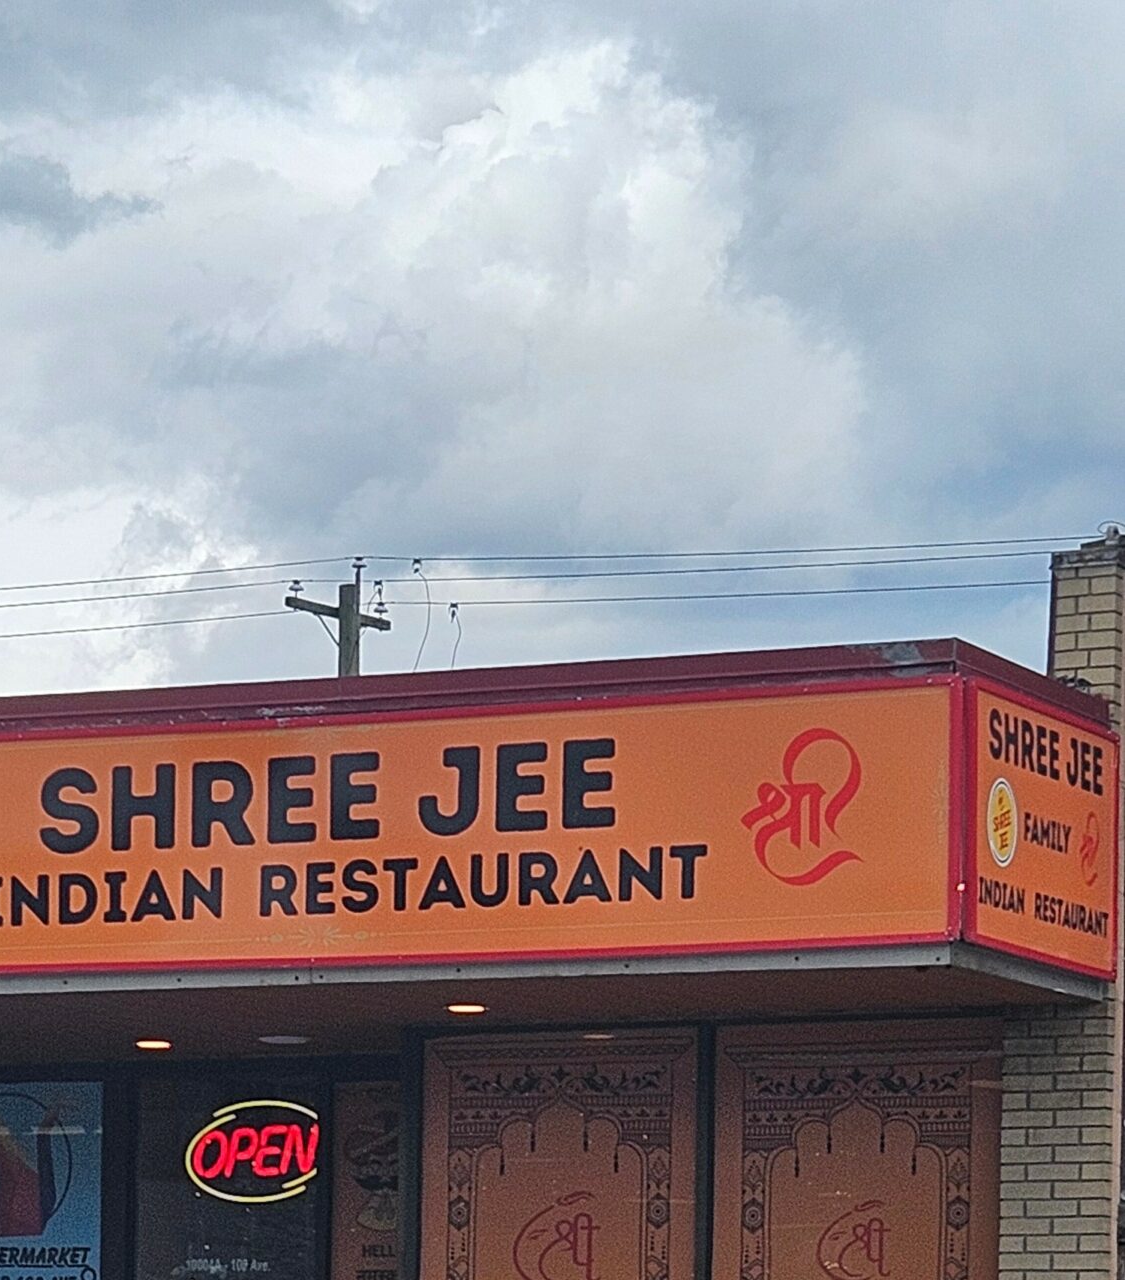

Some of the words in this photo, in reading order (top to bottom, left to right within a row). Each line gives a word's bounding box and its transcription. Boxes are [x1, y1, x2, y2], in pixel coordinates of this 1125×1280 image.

[989, 708, 1060, 781] SHREE
[1065, 737, 1104, 796] JEE
[39, 751, 381, 855] SHREE
[419, 737, 616, 838] JEE
[1024, 812, 1071, 854] FAMILY
[260, 844, 708, 919] RESTAURANT
[979, 876, 1025, 915] INDIAN
[1034, 893, 1110, 938] RESTAURANT
[191, 1123, 320, 1178] OPEN
